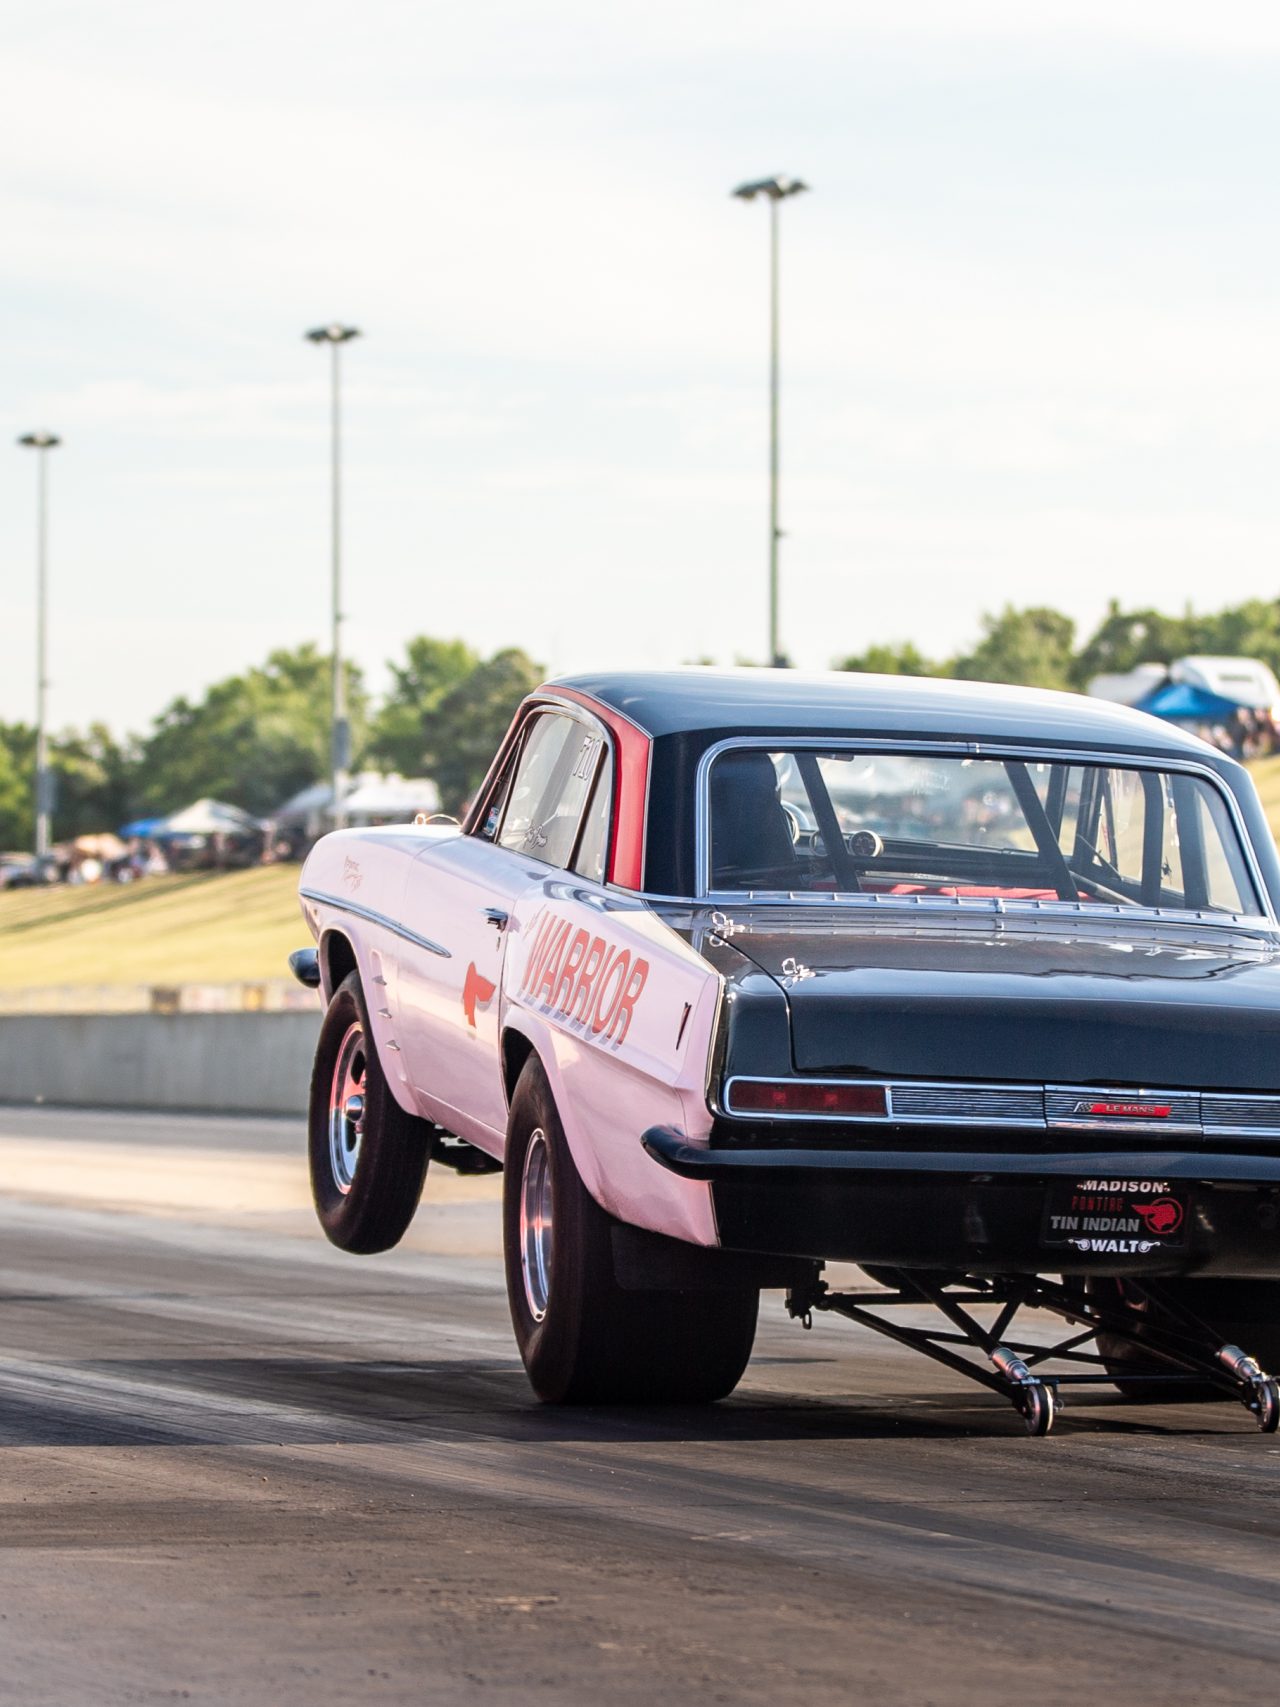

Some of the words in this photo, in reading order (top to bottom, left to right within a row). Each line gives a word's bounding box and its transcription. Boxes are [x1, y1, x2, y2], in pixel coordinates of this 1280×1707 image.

[519, 911, 649, 1047] WARRIOR
[1106, 1104, 1120, 1112] LE
[1123, 1105, 1155, 1113] MANS
[1083, 1180, 1164, 1193] MADISON
[1071, 1196, 1124, 1212] PONTIAC
[1050, 1215, 1078, 1230] TIN
[1082, 1217, 1140, 1232] INDIAN
[1091, 1239, 1138, 1253] WALT
